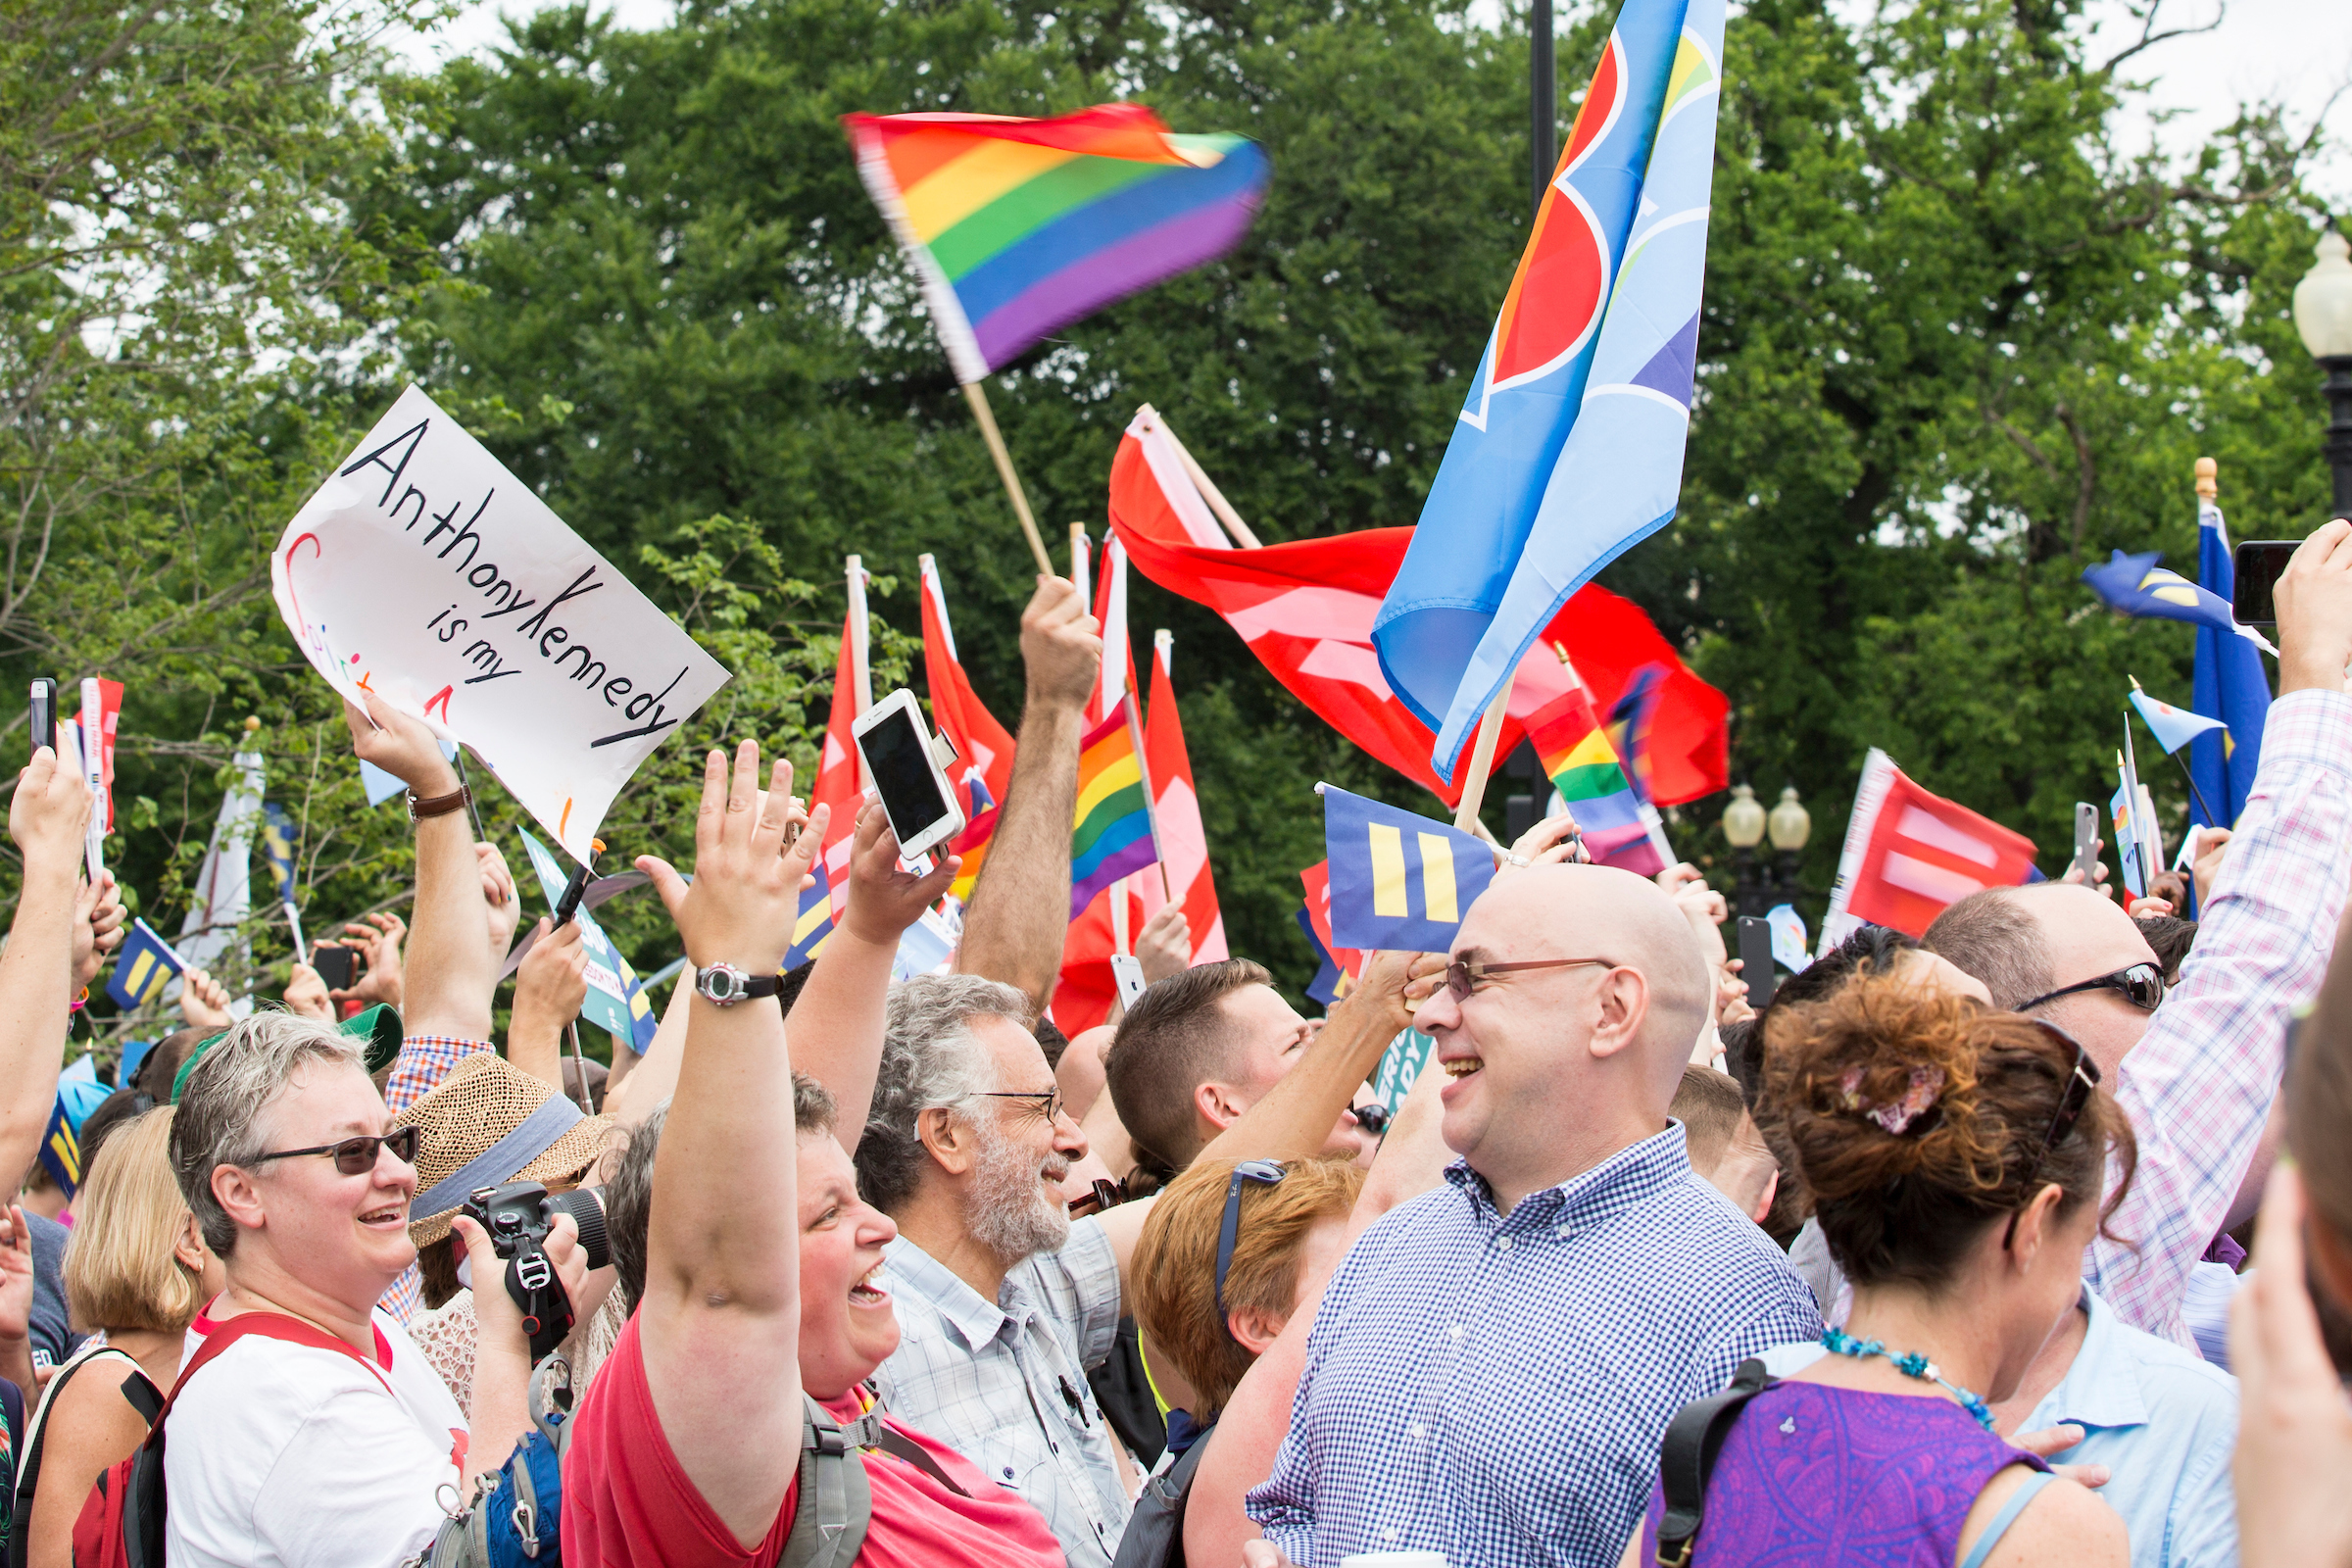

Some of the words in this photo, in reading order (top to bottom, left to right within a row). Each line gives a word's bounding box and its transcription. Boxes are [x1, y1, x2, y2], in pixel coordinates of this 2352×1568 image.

[340, 416, 537, 619] Anthony
[515, 564, 690, 750] Kennedy
[427, 604, 467, 644] is
[462, 639, 523, 685] my
[1392, 1030, 1421, 1117] ADY
